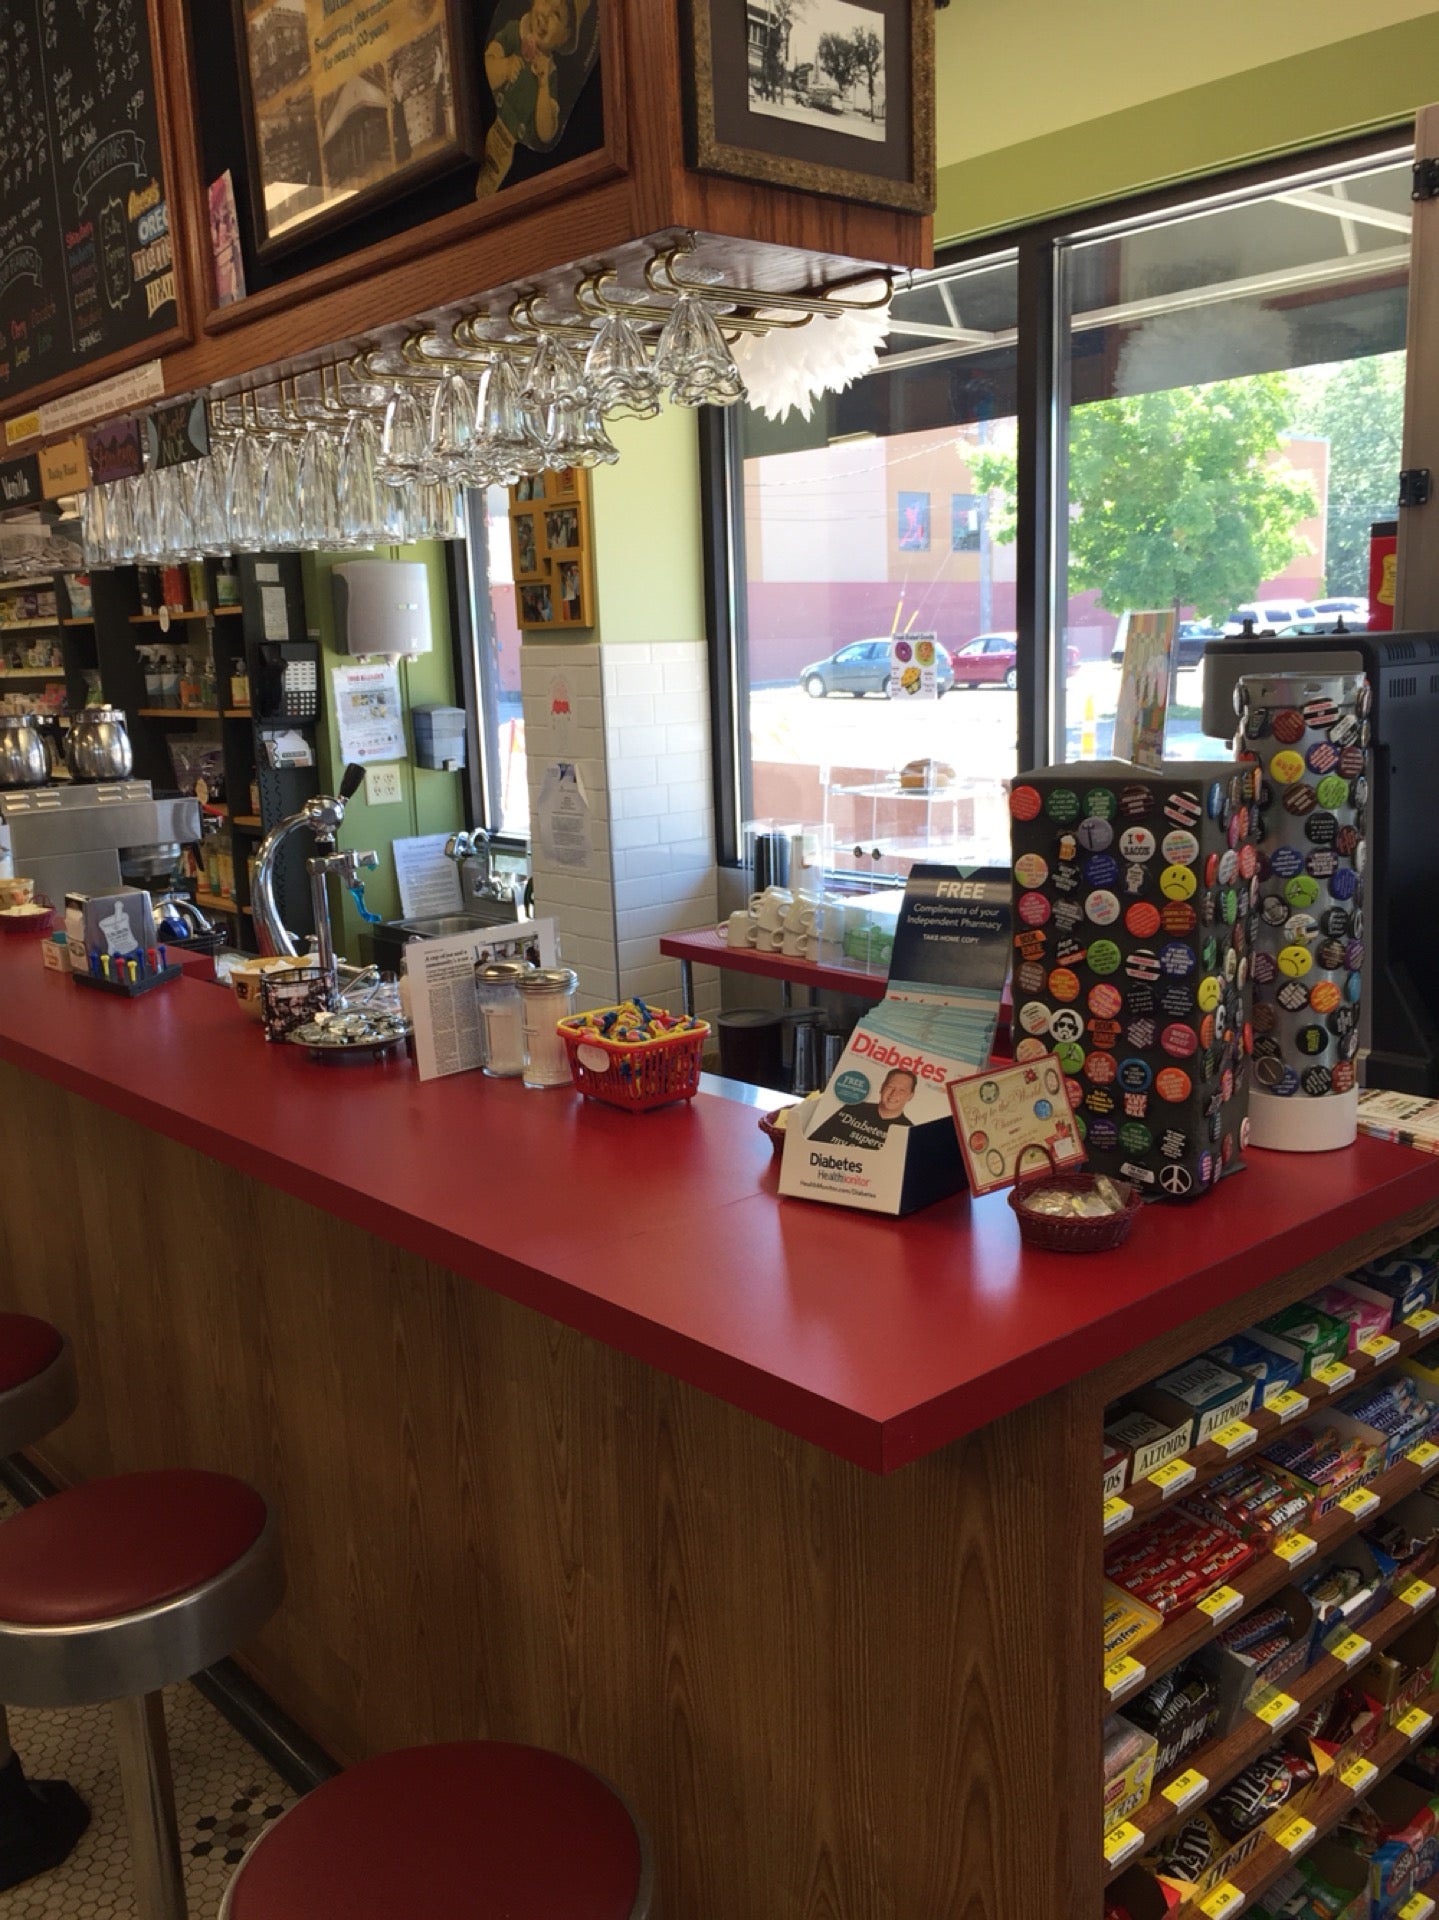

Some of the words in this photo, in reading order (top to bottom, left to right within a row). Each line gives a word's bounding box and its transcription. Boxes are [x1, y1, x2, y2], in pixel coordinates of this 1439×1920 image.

[1128, 834, 1132, 844] I
[1123, 846, 1151, 856] BACON
[936, 881, 987, 900] FREE
[913, 903, 968, 916] Compliments
[969, 906, 980, 916] of
[980, 909, 1000, 918] your
[907, 915, 959, 928] Independent
[960, 918, 1002, 931] Pharmacy
[923, 933, 939, 942] TAKE
[939, 935, 960, 943] HOME
[961, 936, 981, 944] COPY
[850, 1032, 948, 1084] Diabetes
[809, 1153, 863, 1174] Diabetes
[1204, 1397, 1250, 1434] ALTOIDS
[1139, 1430, 1188, 1473] ALTOIDS
